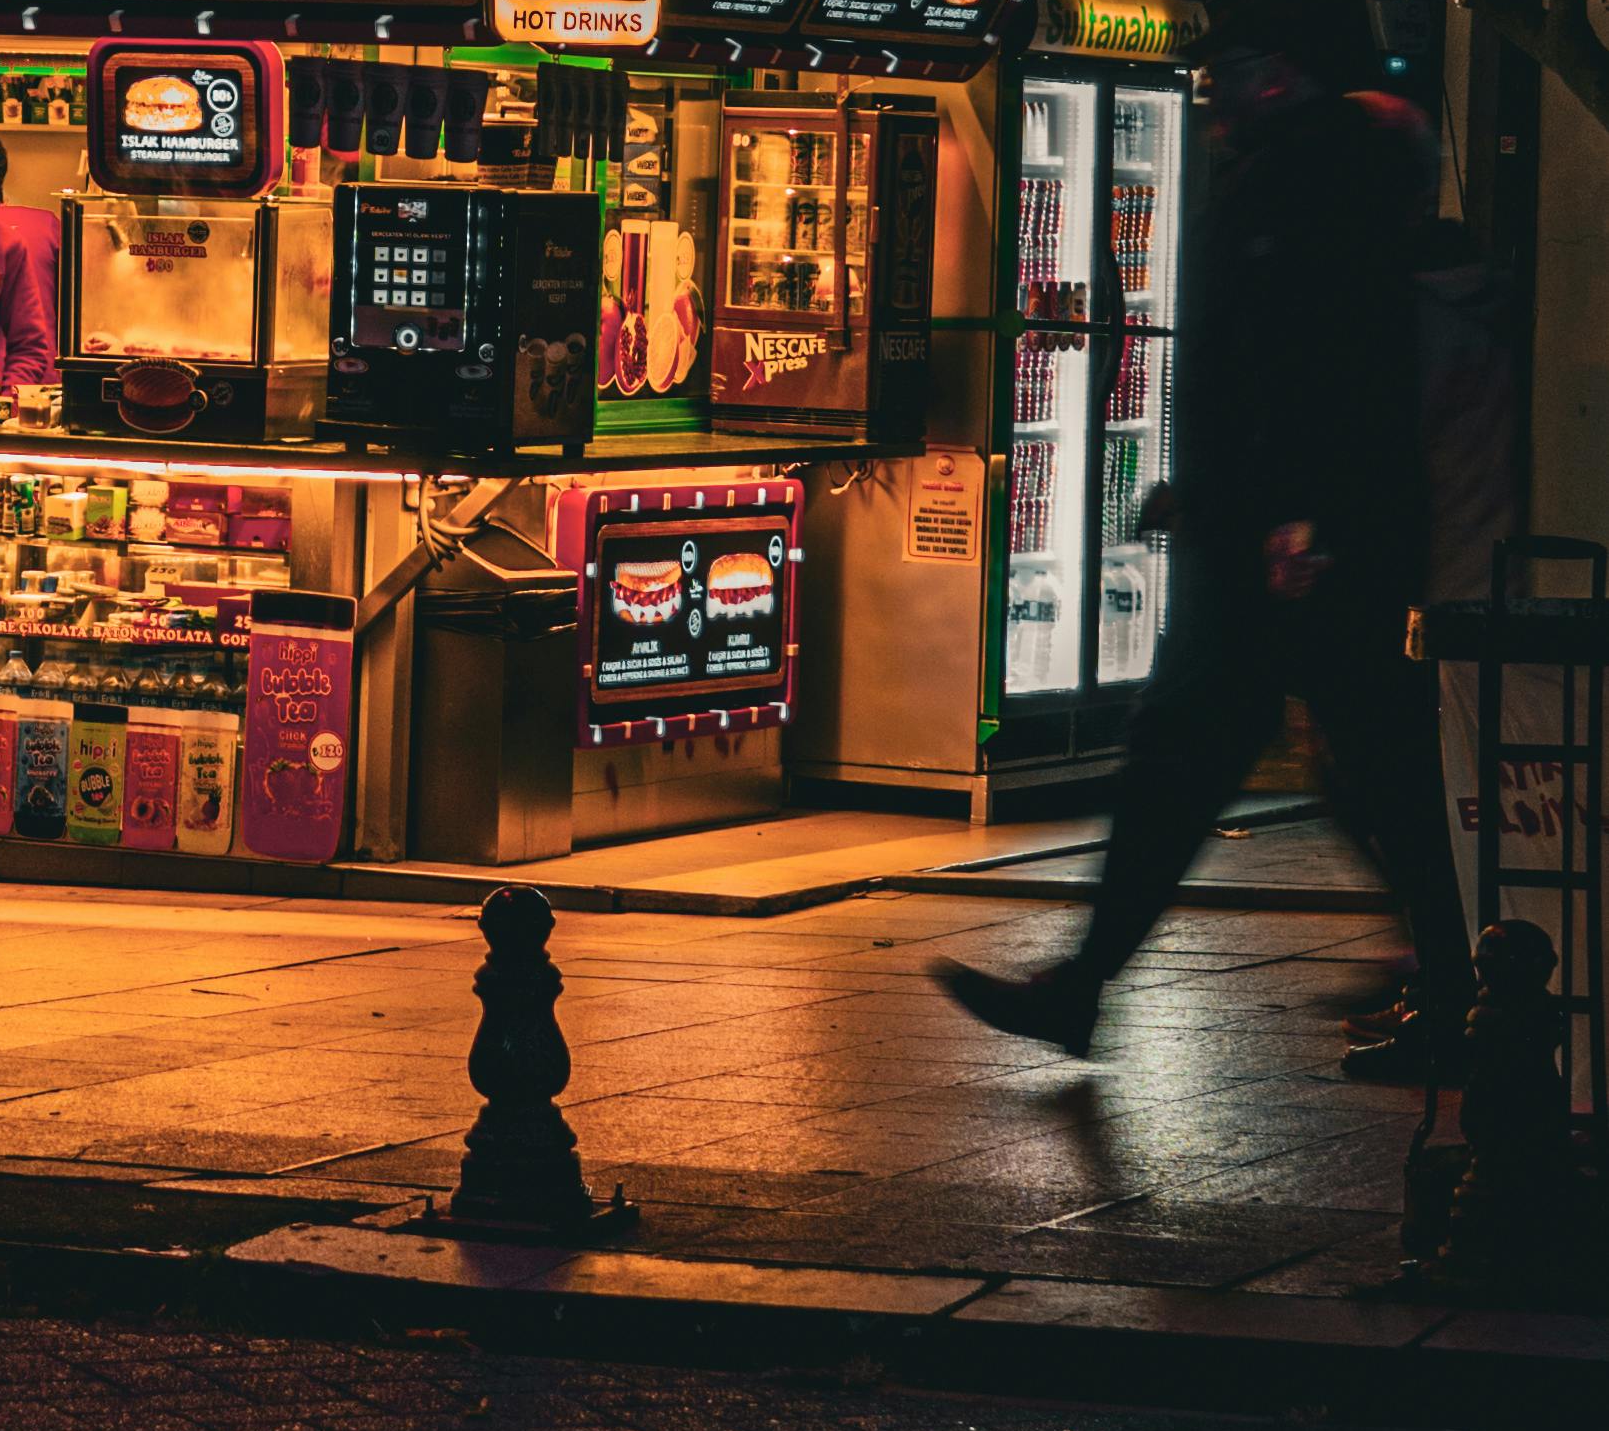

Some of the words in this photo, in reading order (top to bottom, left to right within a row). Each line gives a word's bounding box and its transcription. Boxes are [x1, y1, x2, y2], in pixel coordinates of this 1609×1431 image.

[513, 10, 557, 30] HOT
[563, 12, 643, 33] DRINKS
[120, 134, 160, 149] ISLAK
[160, 136, 240, 151] HAMBURGER
[147, 231, 186, 244] ISLAK
[129, 244, 208, 259] HAMBURGER
[742, 356, 809, 392] Xpress
[18, 608, 45, 620] 100
[149, 612, 167, 626] 50
[92, 625, 140, 641] BATON
[279, 640, 319, 665] hippi
[275, 693, 317, 723] Tea
[80, 738, 117, 761] hippi
[81, 774, 111, 792] BUBBLE
